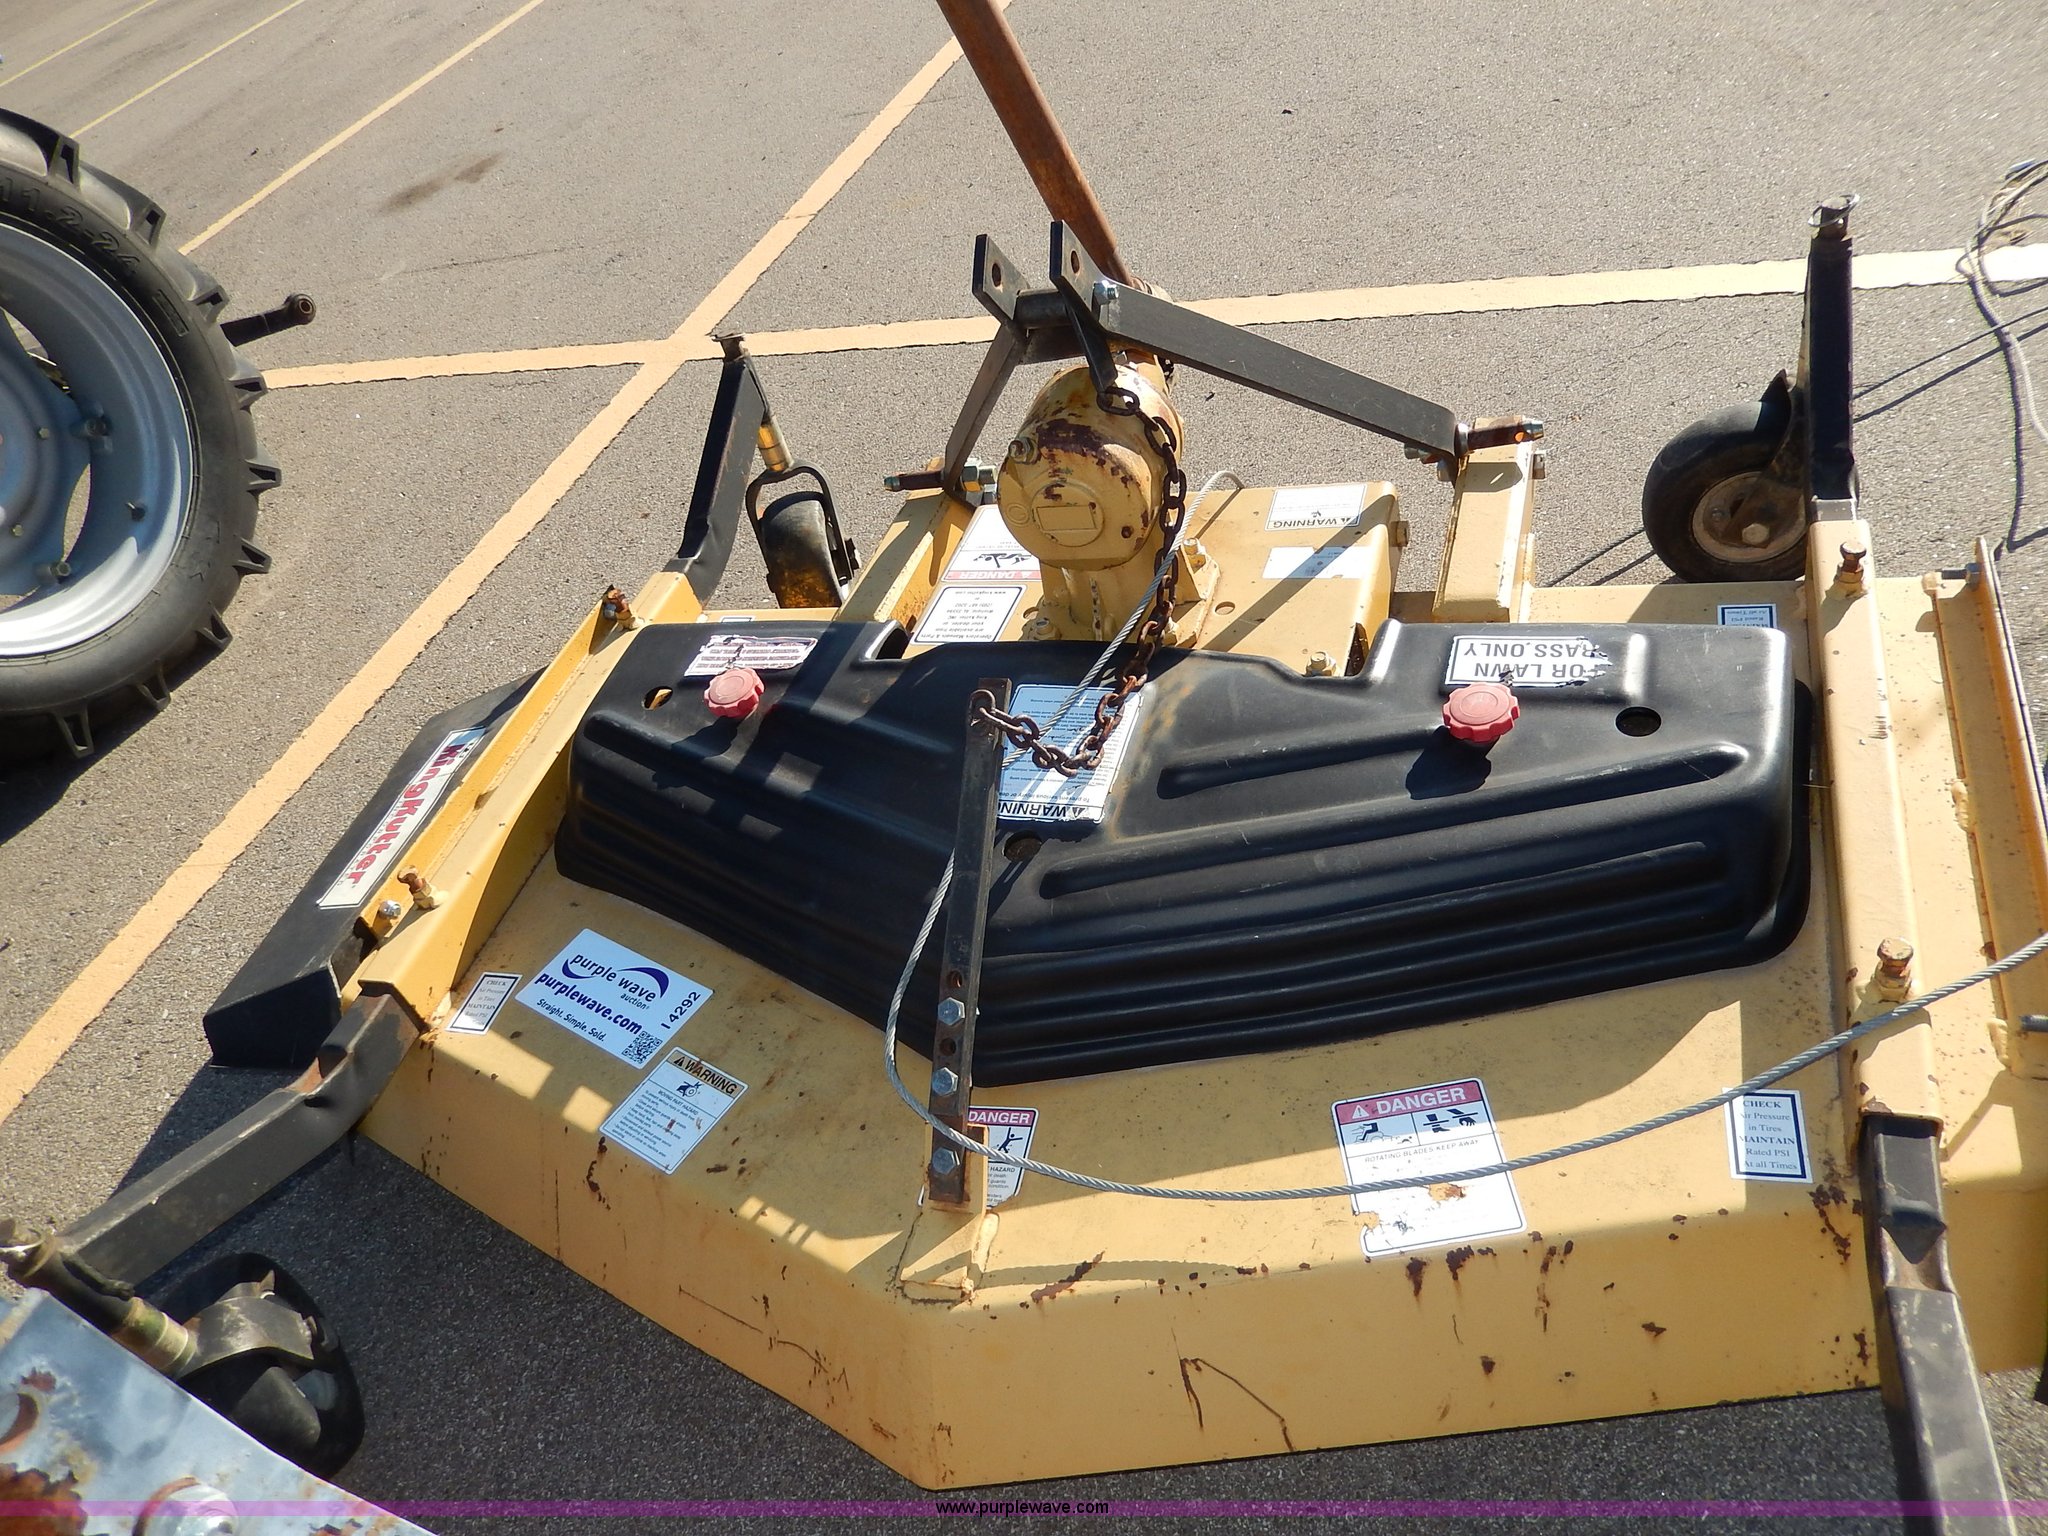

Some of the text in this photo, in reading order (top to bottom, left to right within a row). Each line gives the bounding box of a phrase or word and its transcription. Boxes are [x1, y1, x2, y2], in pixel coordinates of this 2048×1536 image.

[1272, 519, 1338, 528] WARNING
[959, 571, 1017, 580] DANGER
[1464, 643, 1598, 658] RASS ONLY
[998, 801, 1067, 818] WARNIN
[570, 954, 657, 1002] purple wave
[534, 973, 642, 1035] purplewave.com
[536, 998, 606, 1042] Straight. Simple. Sold.
[684, 1058, 738, 1096] WARNING
[1375, 1087, 1467, 1115] DANGER
[1743, 1100, 1782, 1109] CHECK
[968, 1111, 1031, 1124] DANGER
[1753, 1112, 1791, 1121] Pressure
[1758, 1124, 1783, 1132] Tires
[1364, 1139, 1479, 1163] ROTATING BLADES KEEP AWAY
[1746, 1148, 1790, 1157] Rated PSI
[1768, 1161, 1798, 1170] Times
